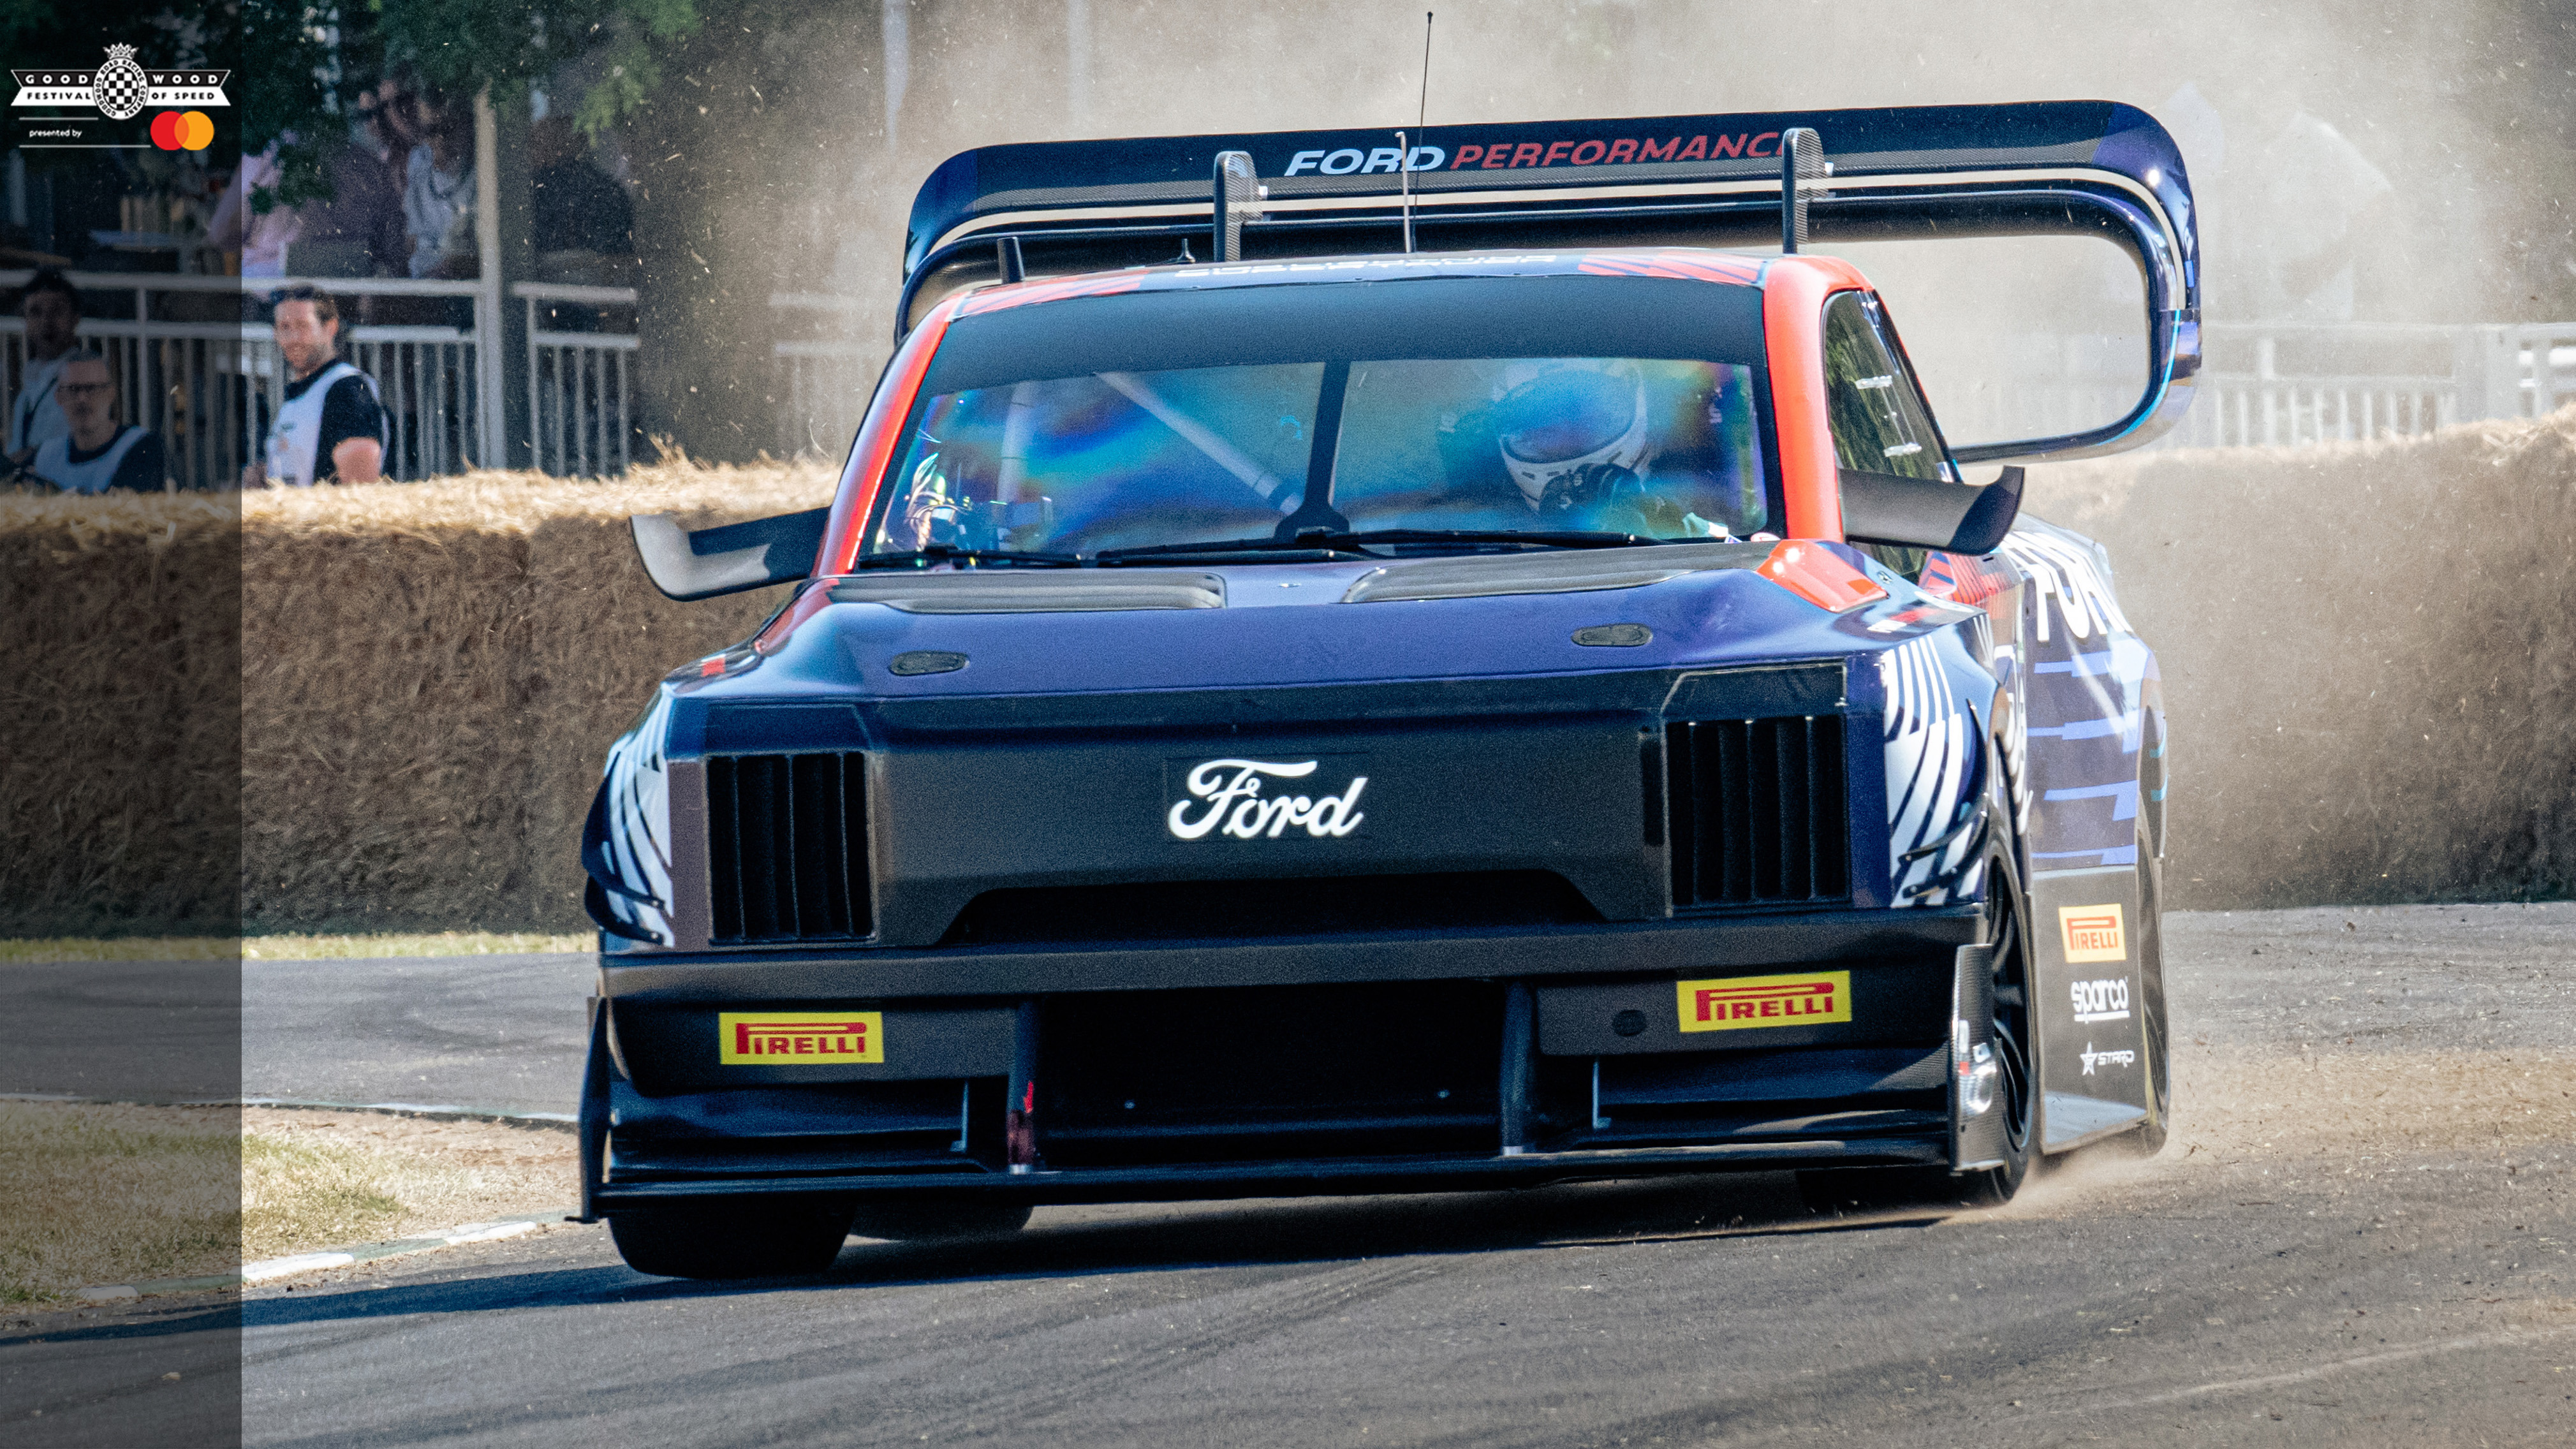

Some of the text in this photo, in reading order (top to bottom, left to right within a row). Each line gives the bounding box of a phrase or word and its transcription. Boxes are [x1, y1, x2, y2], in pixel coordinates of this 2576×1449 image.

[1283, 131, 1783, 177] FORD PERFORMANC
[1168, 758, 1369, 839] Ford
[2066, 915, 2119, 951] PIRELLI
[1695, 982, 1834, 1022] PIRELLI
[2070, 978, 2130, 1024] sparco
[735, 1022, 867, 1055] PIRELLI
